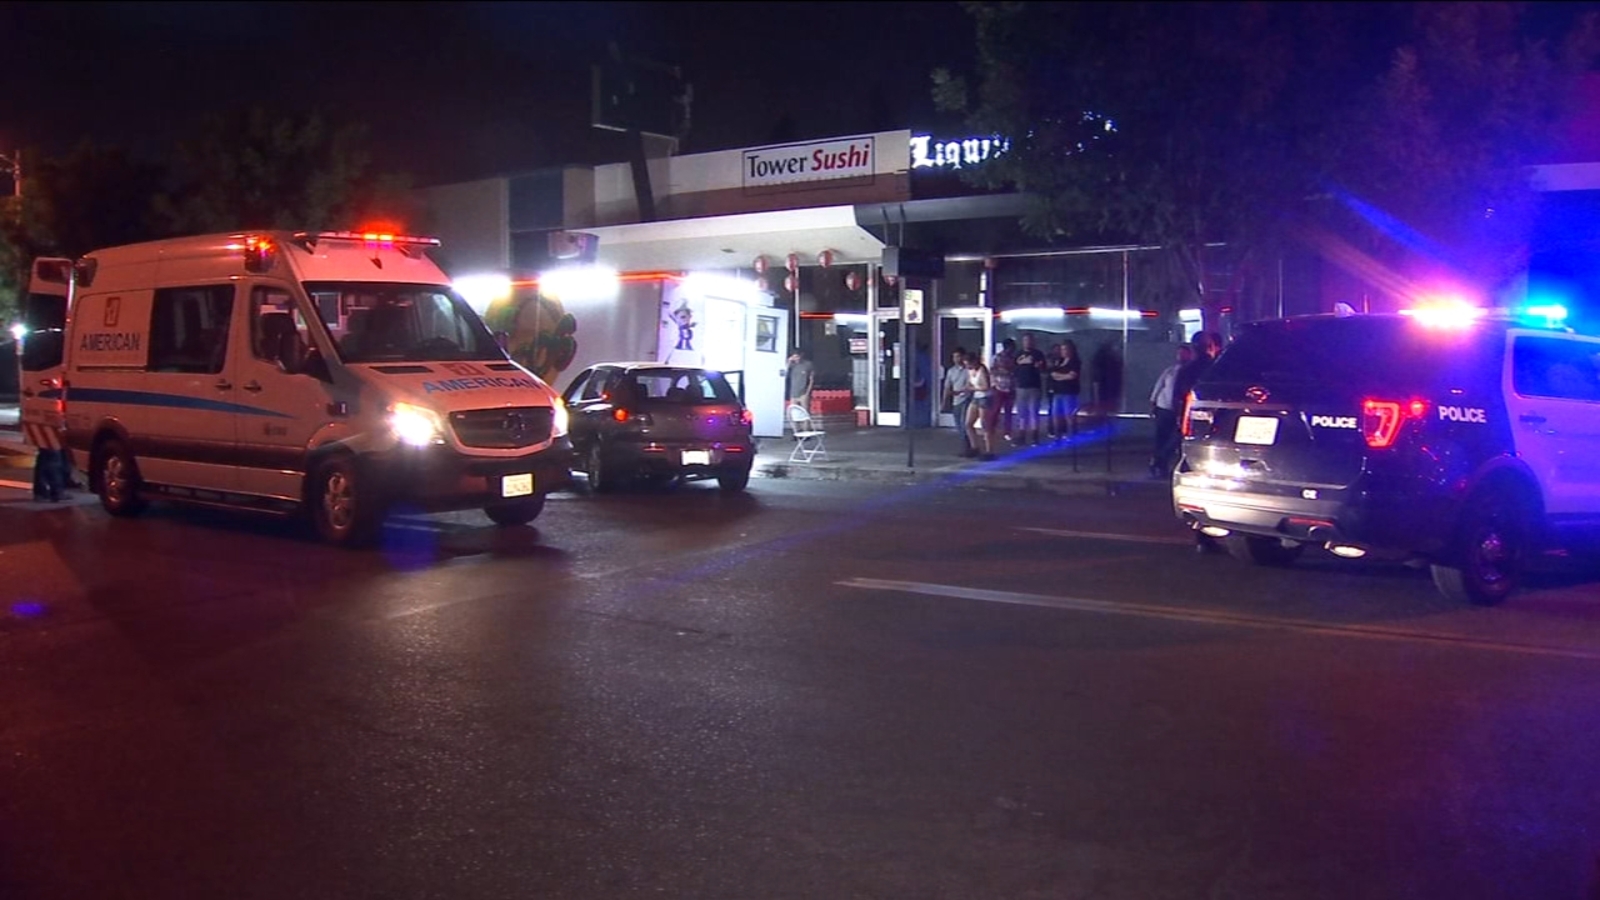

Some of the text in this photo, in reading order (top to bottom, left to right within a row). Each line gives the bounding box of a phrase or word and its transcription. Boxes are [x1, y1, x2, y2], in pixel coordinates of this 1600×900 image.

[746, 144, 870, 178] Tower Sushi
[80, 332, 141, 352] AMERICAN
[422, 377, 543, 395] AMERICAN
[1311, 415, 1358, 429] POLICE
[1438, 405, 1488, 424] POLICE
